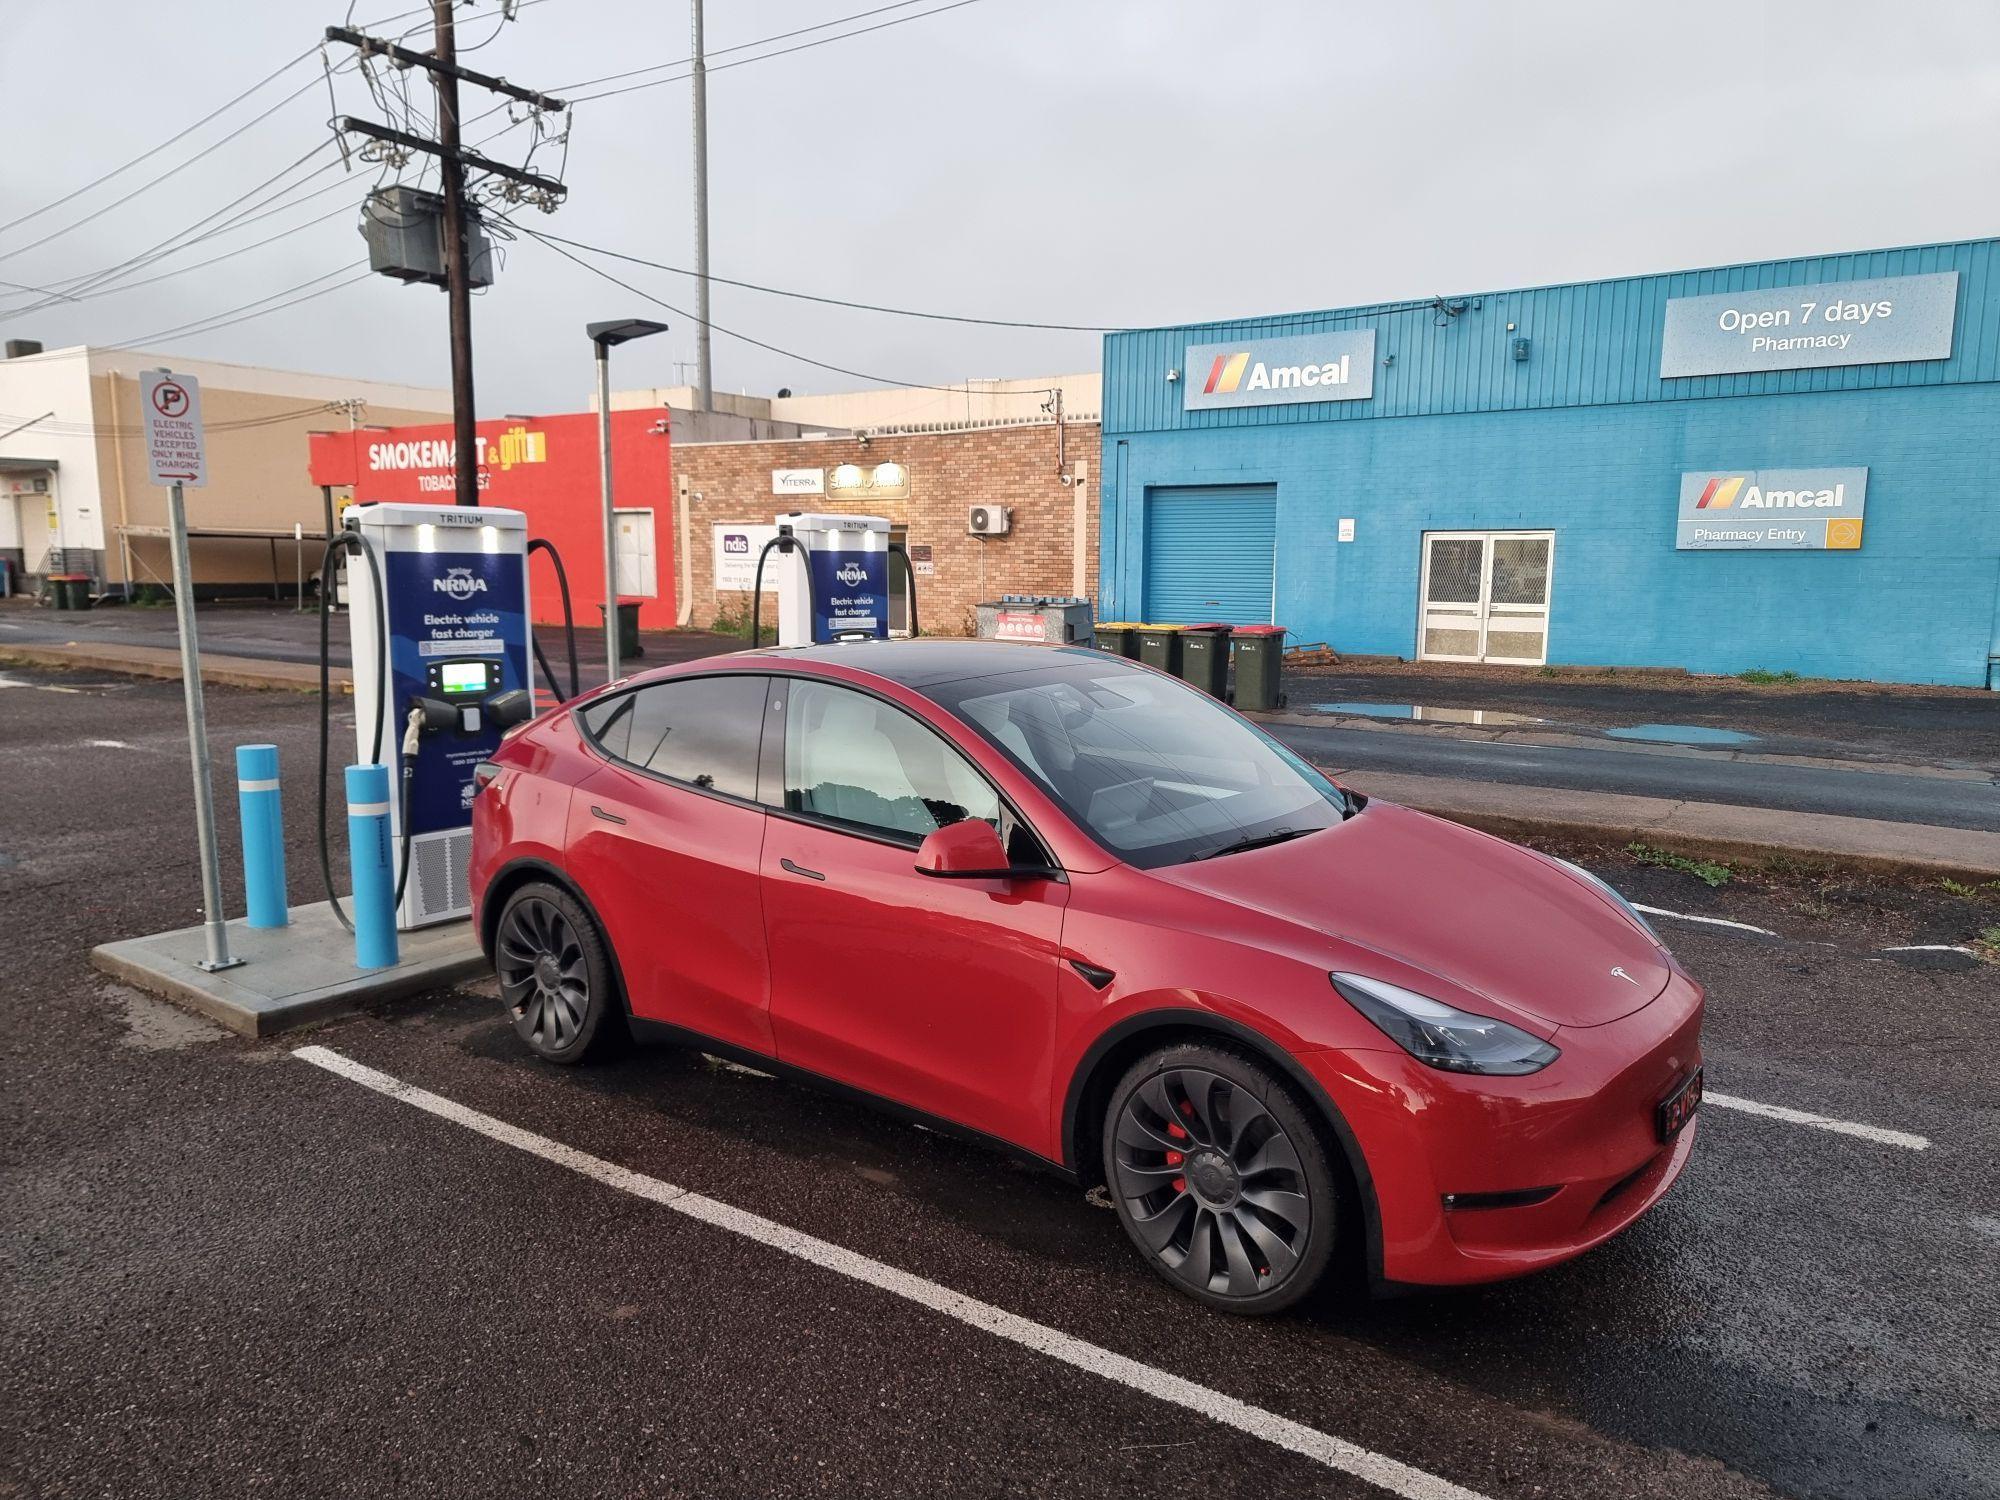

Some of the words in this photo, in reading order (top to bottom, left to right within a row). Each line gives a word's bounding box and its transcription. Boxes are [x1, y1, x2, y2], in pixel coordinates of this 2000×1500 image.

[1719, 308, 1790, 334] Open
[1800, 302, 1816, 325] 7
[1823, 299, 1892, 325] days
[1752, 333, 1851, 352] Pharmacy
[1246, 354, 1350, 391] Amcal
[153, 420, 193, 430] ELECTRIC
[154, 430, 196, 440] VEHICLES
[154, 440, 197, 449] EXCEPTED
[152, 450, 173, 458] ONLY
[176, 450, 200, 460] WHILE
[369, 437, 487, 471] SMOKEMT
[488, 446, 499, 464] &
[156, 460, 199, 469] CHARGING
[1740, 483, 1845, 509] Amcal
[440, 514, 483, 524] TRITIUM
[843, 521, 868, 529] TRITIUM
[1694, 528, 1764, 542] Pharmacy
[1767, 529, 1806, 543] Entry
[725, 536, 747, 552] ndis
[836, 569, 868, 581] NRMA
[433, 578, 488, 592] NRMA
[831, 597, 852, 605] Electric
[854, 597, 873, 605] vehicle
[835, 608, 847, 616] fast
[848, 608, 870, 616] charger
[424, 614, 462, 625] Electric
[464, 613, 499, 624] vehicle
[431, 628, 453, 639] fast
[455, 628, 494, 640] charger
